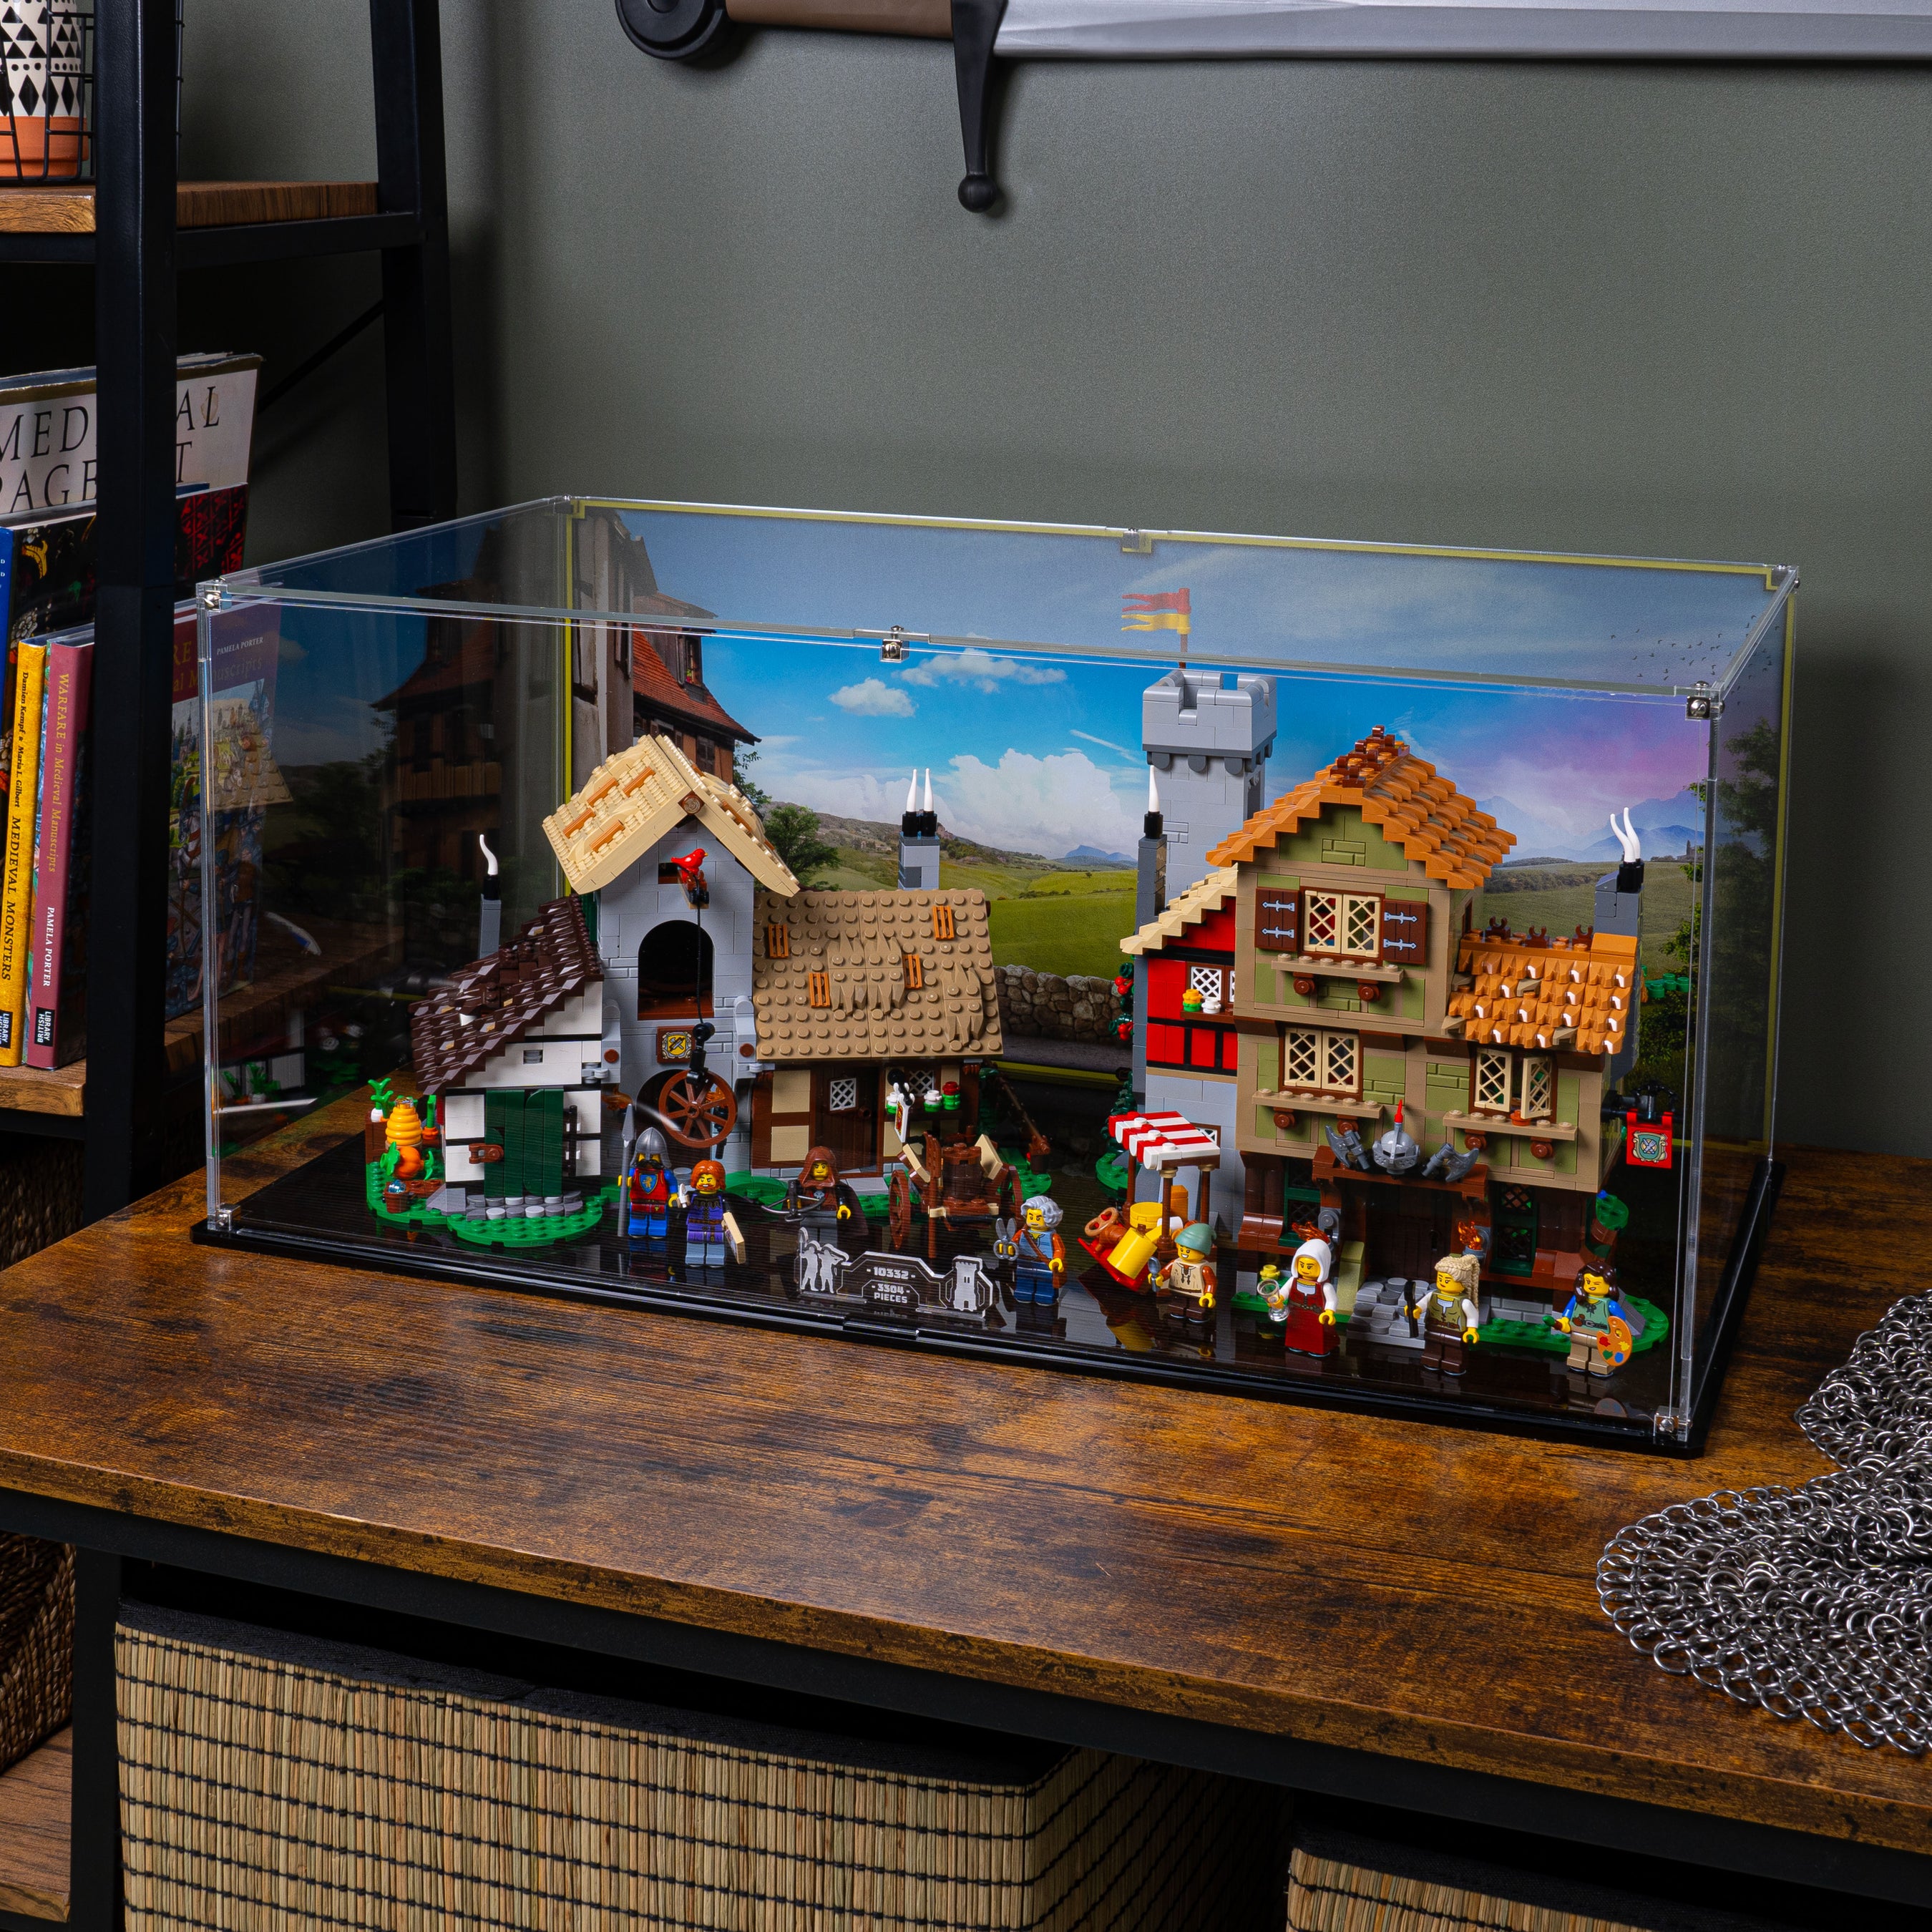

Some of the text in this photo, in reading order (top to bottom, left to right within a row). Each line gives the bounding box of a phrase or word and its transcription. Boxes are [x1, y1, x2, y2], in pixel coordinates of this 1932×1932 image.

[0, 386, 220, 462] MEDAL
[0, 441, 192, 513] AGET
[217, 637, 263, 655] PAMELA PORTER
[18, 706, 26, 734] Kempf
[49, 673, 69, 872] WARFARE in Medieval Manuscripts
[1, 816, 21, 980] MEDIEVAL MONSTERS
[43, 907, 54, 987] PAMELA PORTER
[874, 1267, 909, 1279] 10332
[874, 1292, 907, 1303] PIECES
[877, 1283, 904, 1294] 3304
